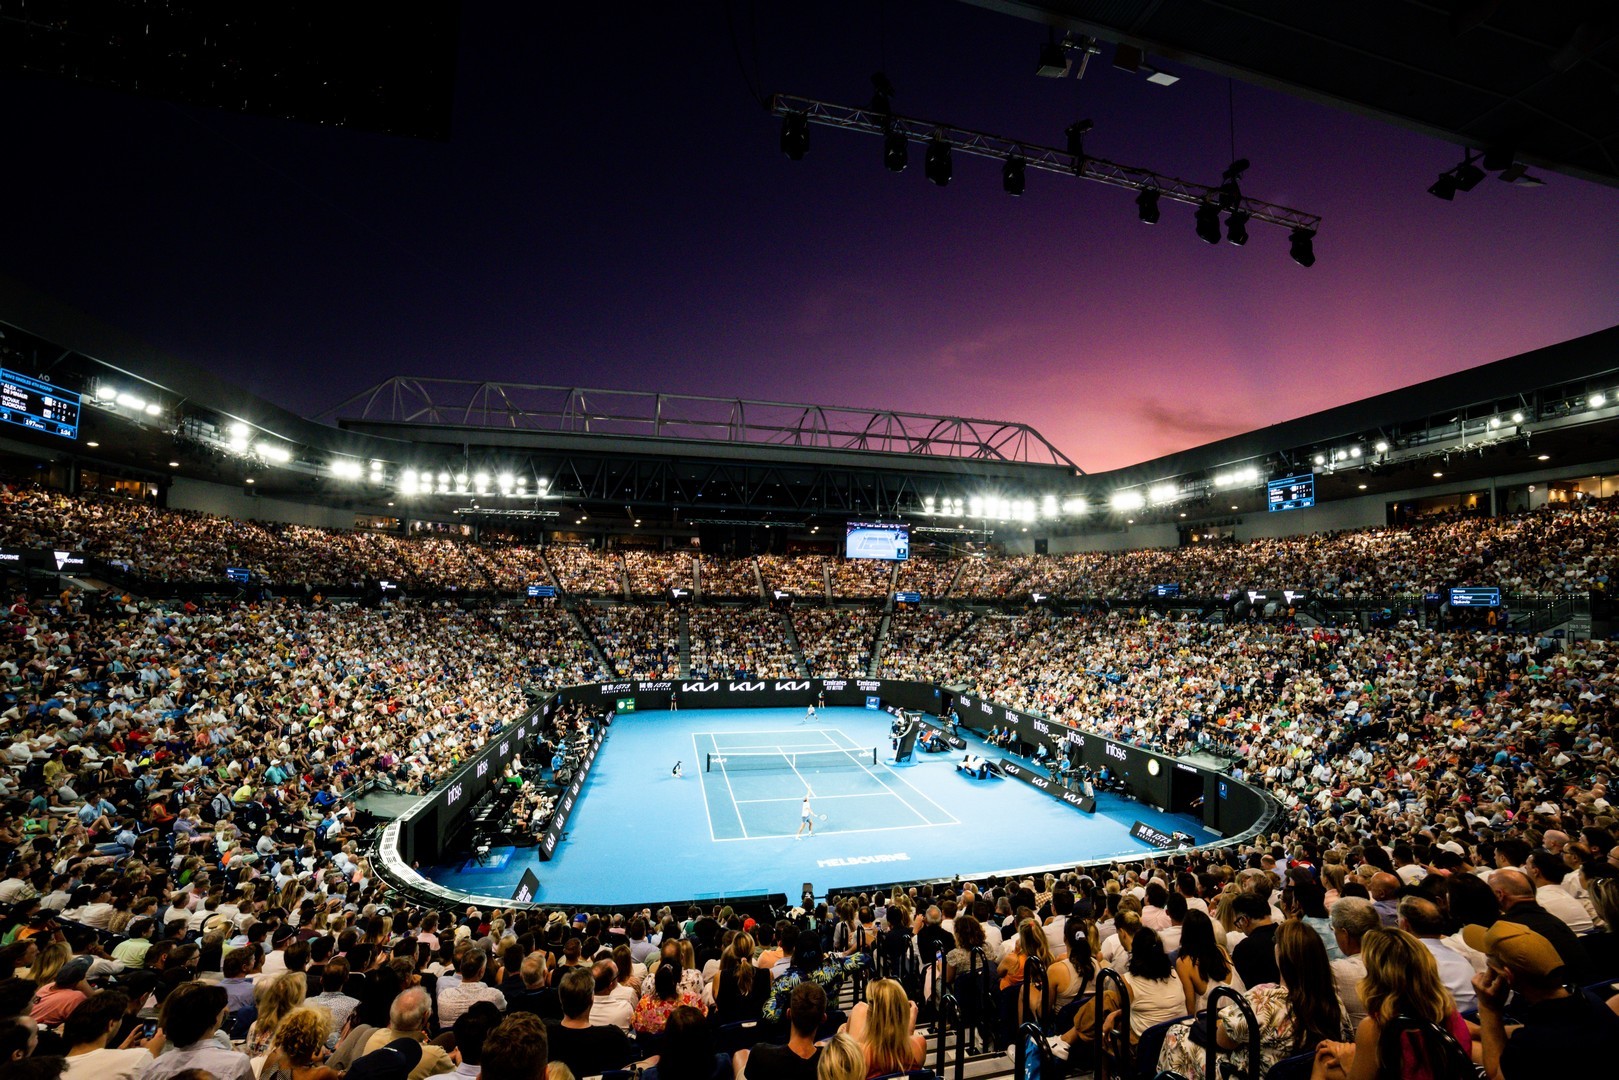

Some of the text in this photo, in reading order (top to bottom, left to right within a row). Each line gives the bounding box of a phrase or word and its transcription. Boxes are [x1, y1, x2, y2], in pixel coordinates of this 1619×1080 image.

[16, 376, 31, 385] SINGLES
[2, 395, 19, 404] NOVAK
[10, 391, 28, 399] MINAUR
[2, 401, 26, 411] DJOKOVIC
[682, 682, 719, 692] KIA
[729, 682, 765, 691] KIA
[775, 681, 810, 691] KIA
[1006, 710, 1018, 724] Infosys
[1034, 719, 1049, 734] Infosys
[949, 737, 960, 745] KIA
[1067, 729, 1084, 746] Infosys
[1106, 742, 1126, 761] Infosys
[477, 759, 488, 778] Infosys
[1005, 764, 1020, 774] KIA
[1032, 776, 1048, 788] KIA
[448, 782, 462, 806] Infosys
[1063, 792, 1083, 805] KIA
[556, 813, 564, 830] KIA
[546, 832, 556, 852] KIA
[816, 852, 911, 868] MELBOURNE
